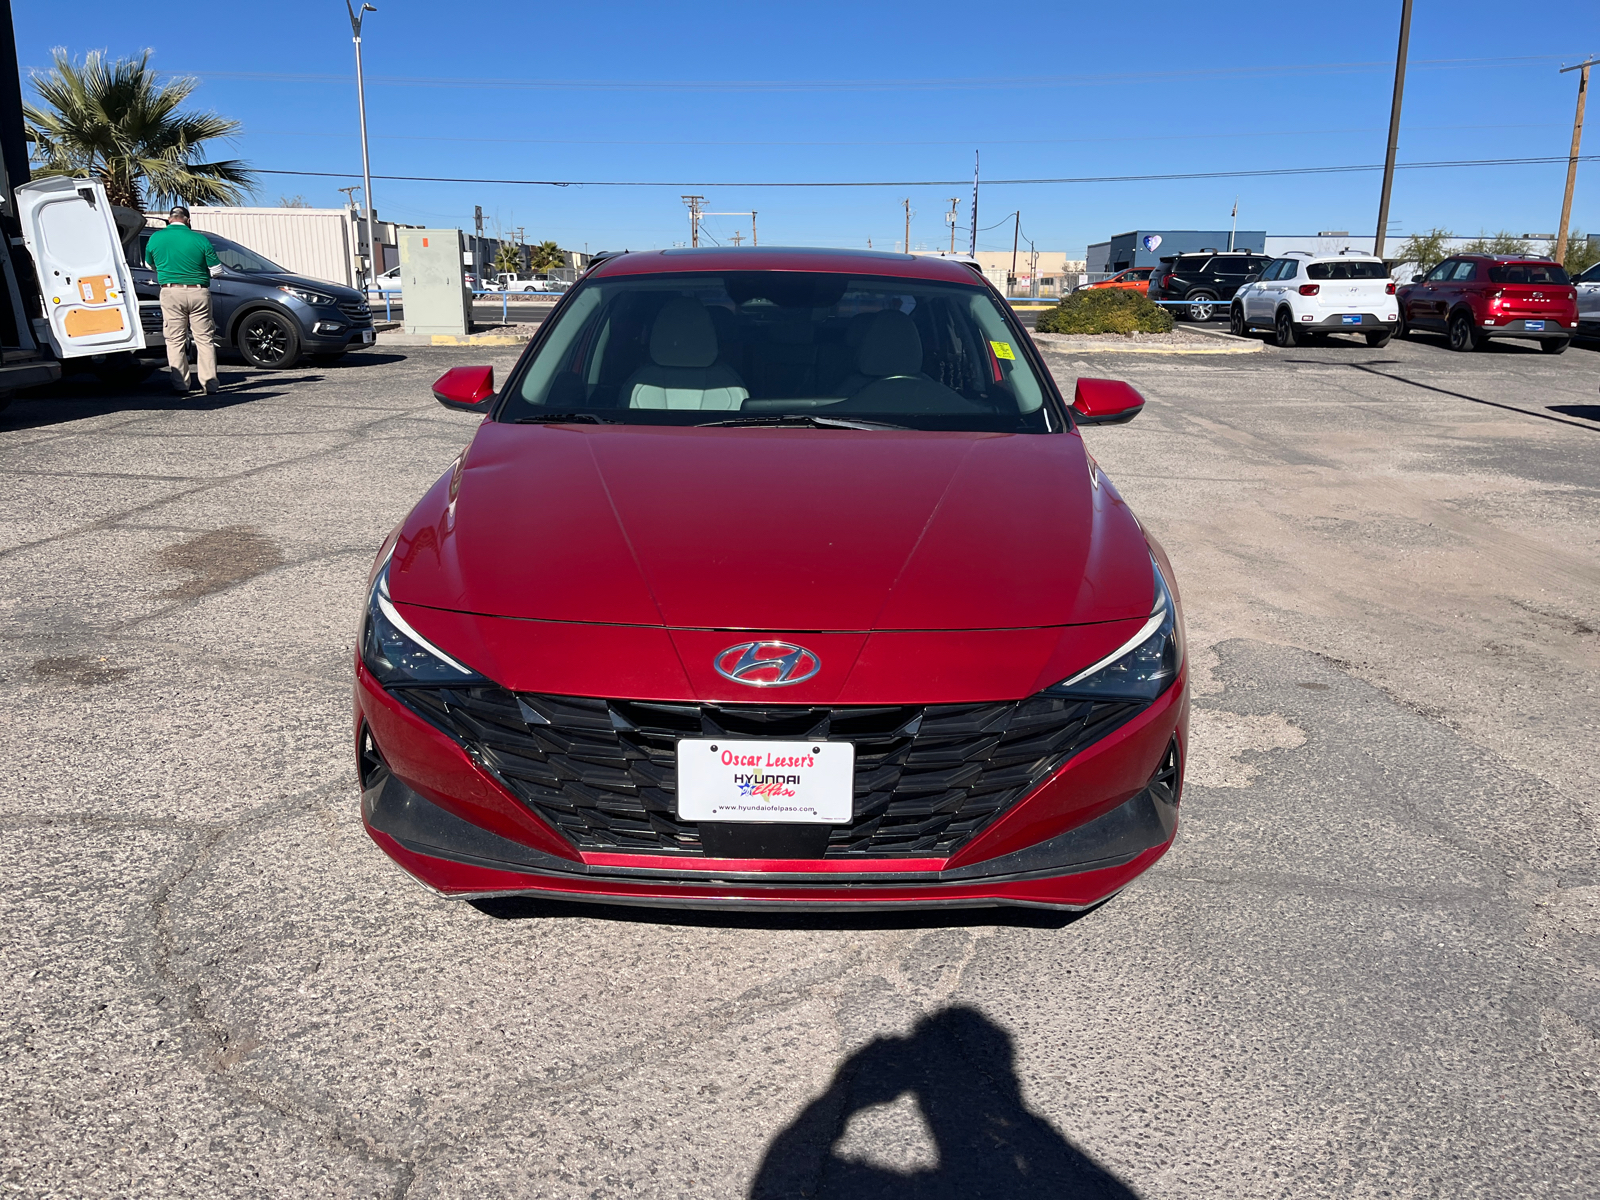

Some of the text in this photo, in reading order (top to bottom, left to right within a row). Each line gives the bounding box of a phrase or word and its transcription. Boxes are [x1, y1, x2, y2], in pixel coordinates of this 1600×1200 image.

[721, 750, 814, 767] Oscar Leeser's
[734, 774, 800, 784] HYUNDAI
[718, 804, 815, 812] www.hyundaiofelpaso.com
